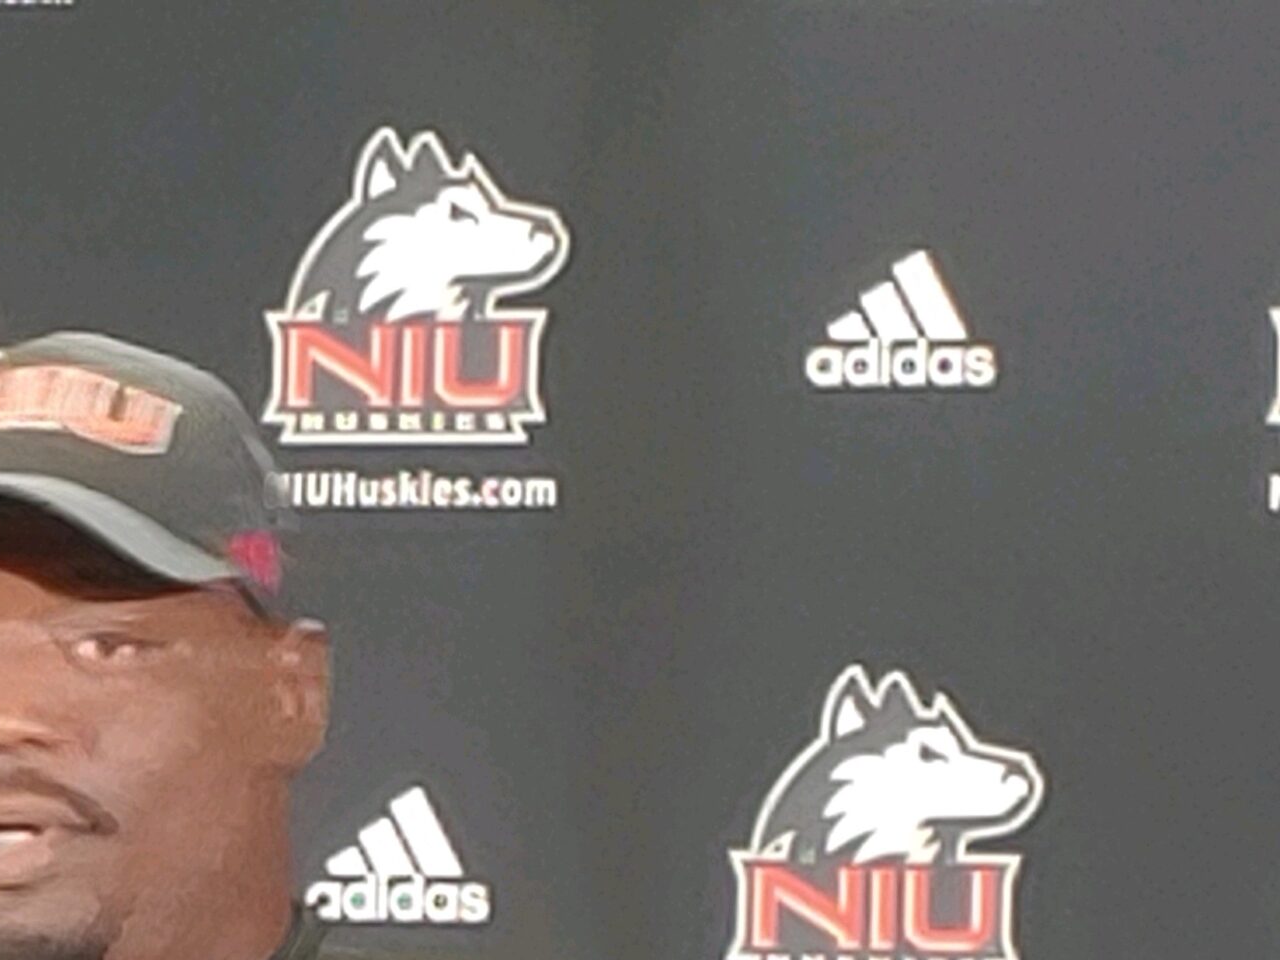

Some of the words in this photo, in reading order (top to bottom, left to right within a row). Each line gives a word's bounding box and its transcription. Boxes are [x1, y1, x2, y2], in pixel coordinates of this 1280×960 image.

[286, 322, 524, 407] NIU
[805, 337, 997, 388] adidas
[305, 872, 491, 924] adidas
[752, 863, 999, 952] NIU
